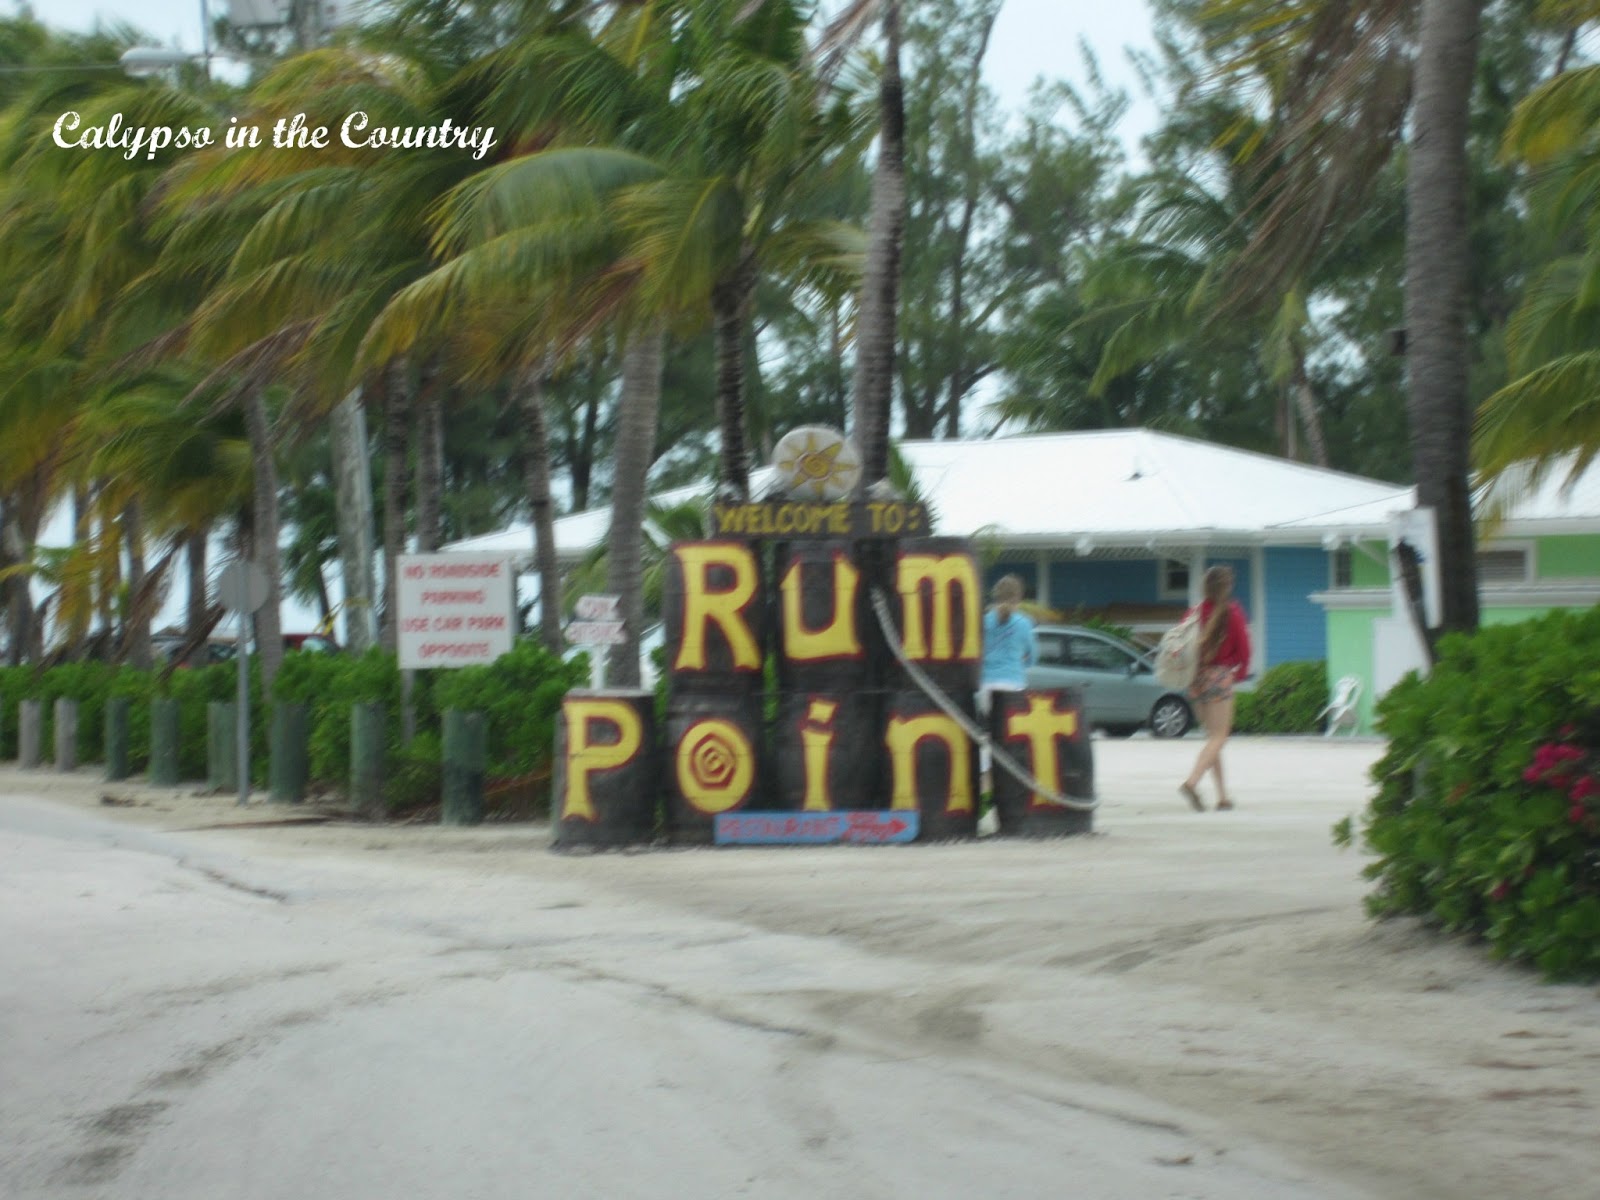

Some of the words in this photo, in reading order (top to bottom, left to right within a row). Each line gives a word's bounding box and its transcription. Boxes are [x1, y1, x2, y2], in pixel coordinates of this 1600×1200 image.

[714, 503, 850, 534] WELCOME
[674, 540, 981, 672] Rum
[401, 617, 429, 633] USE
[433, 616, 463, 632] CAR
[467, 615, 506, 631] PARK
[418, 642, 490, 659] OPPOSITE
[560, 692, 1079, 822] Point
